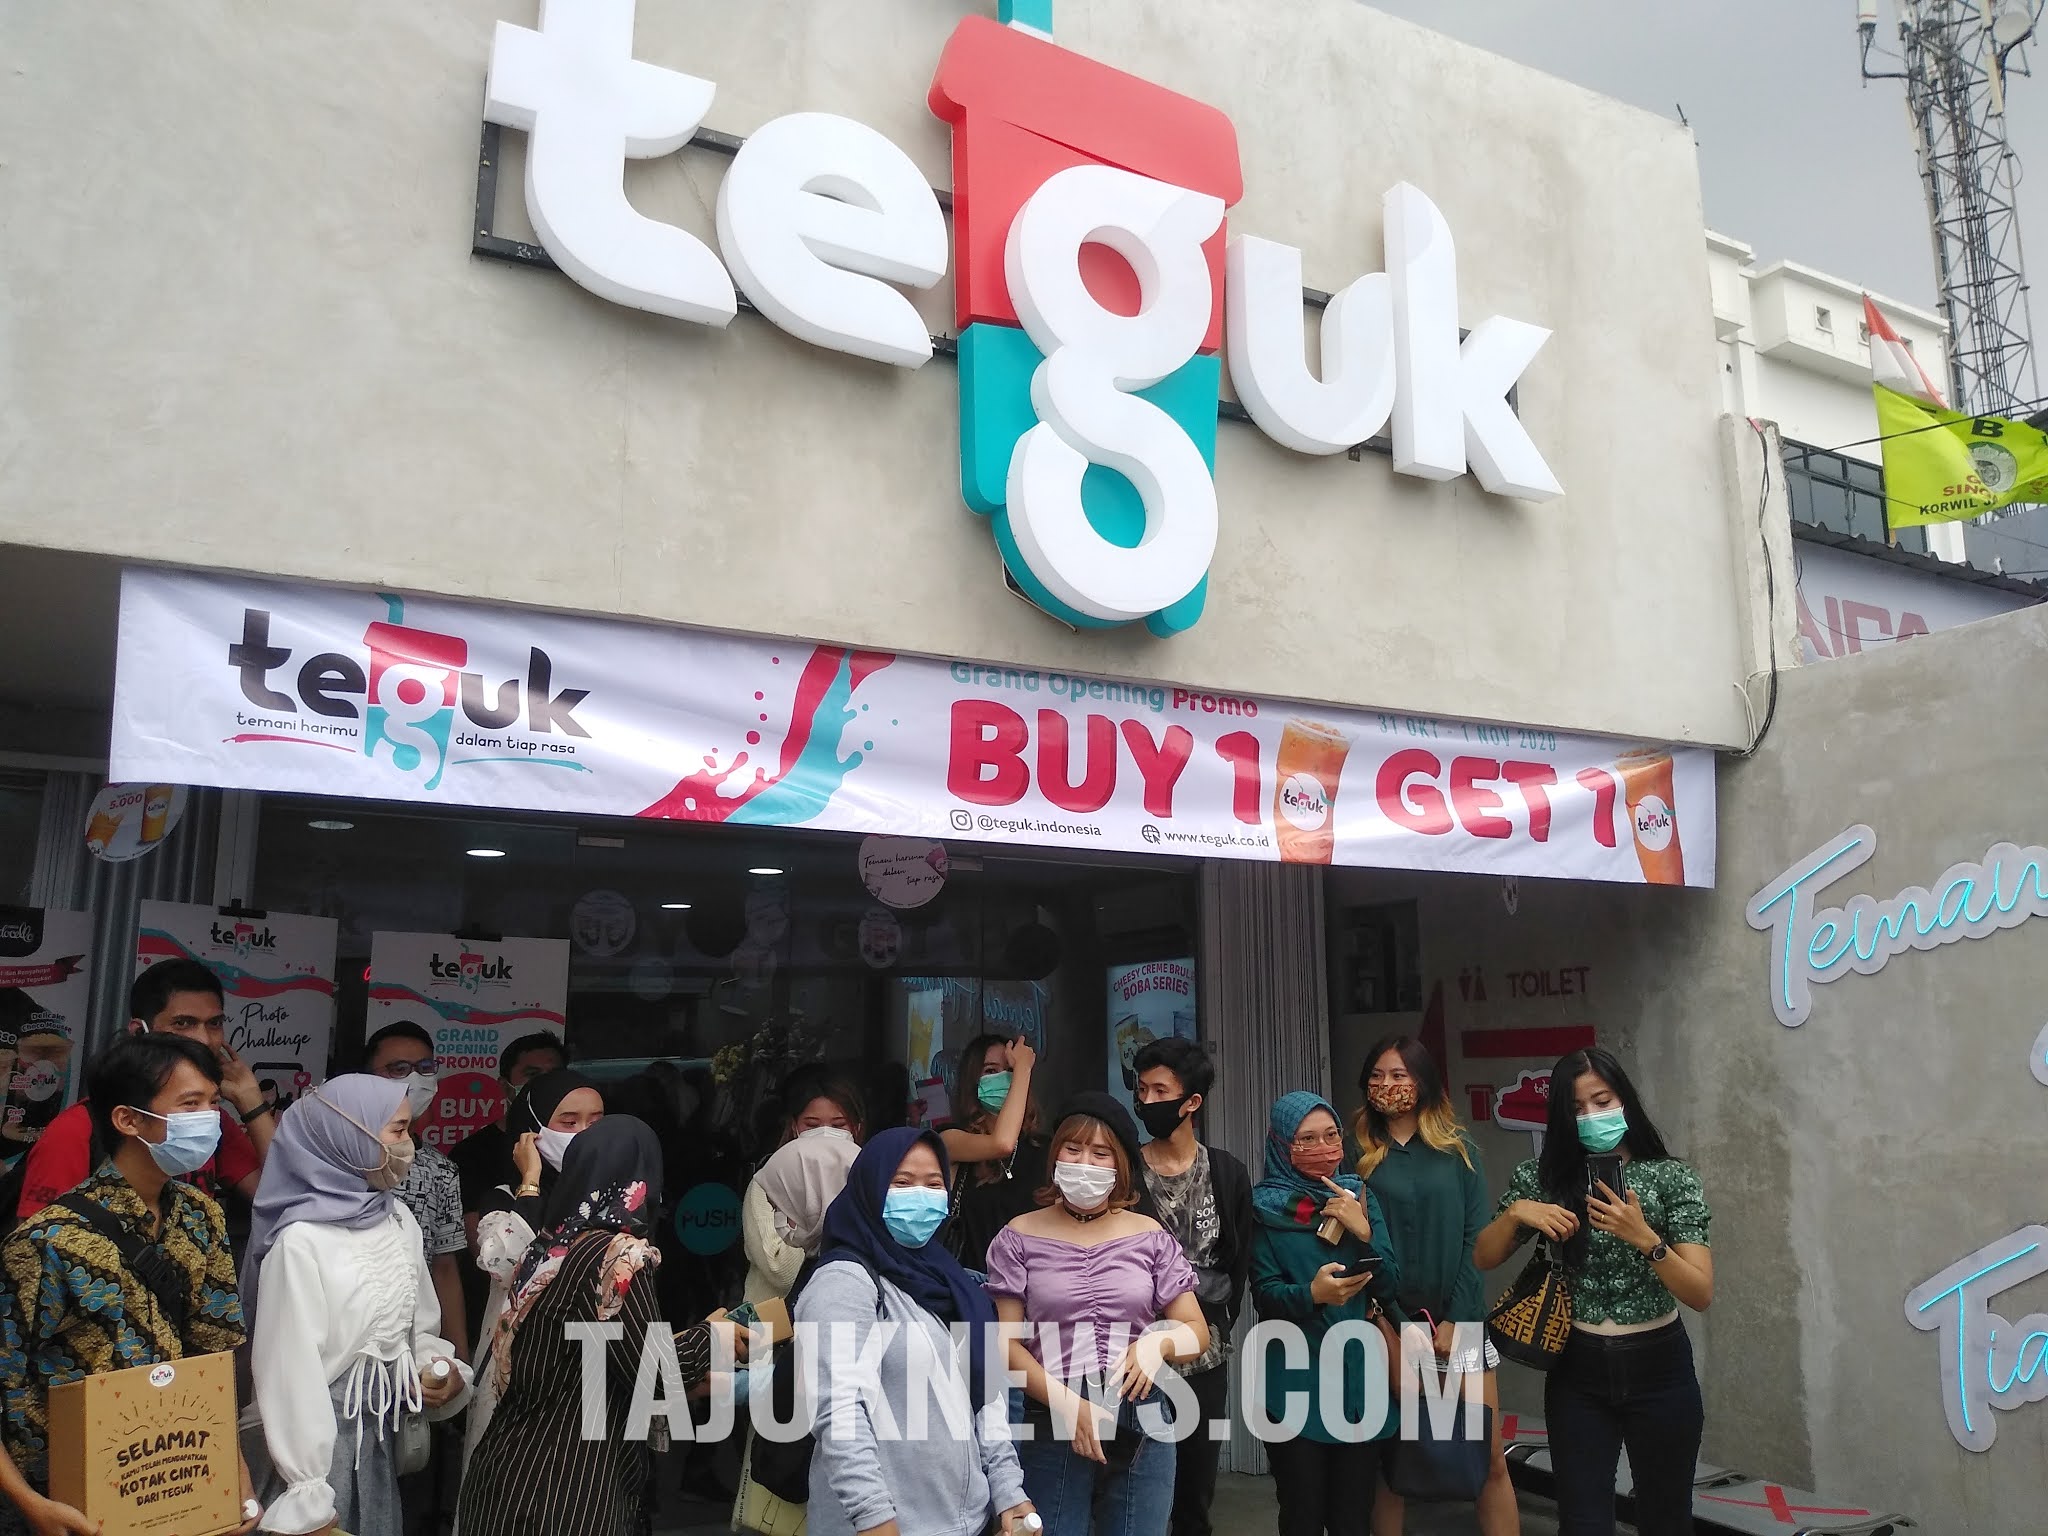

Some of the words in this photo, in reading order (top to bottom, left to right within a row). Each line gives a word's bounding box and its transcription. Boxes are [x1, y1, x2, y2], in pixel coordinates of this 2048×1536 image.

[484, 0, 1564, 620] teguk
[1920, 498, 1978, 515] KORWIL
[228, 608, 592, 790] teguk
[950, 661, 1039, 692] Grand
[1048, 673, 1165, 713] Opening
[1173, 687, 1258, 717] Promo
[236, 711, 297, 731] temani
[301, 718, 358, 737] harimu
[1377, 713, 1398, 735] 31
[1406, 716, 1439, 739] OKT
[1460, 722, 1470, 743] 1
[1477, 724, 1510, 747] NOV
[1517, 729, 1557, 752] 2020
[455, 732, 502, 748] dalam
[506, 735, 537, 756] tiap
[541, 742, 576, 754] rasa
[947, 699, 1194, 818] BUY
[1215, 730, 1263, 825] 1
[1376, 748, 1558, 843] GET
[1576, 767, 1618, 848] 1
[109, 793, 143, 809] 5.000
[977, 815, 1102, 837] @teguk.indonesia
[1165, 829, 1270, 849] www.teguk.co.id
[211, 922, 277, 960] teguk
[429, 953, 514, 994] teguk
[1113, 967, 1141, 993] CHEESY
[1141, 963, 1168, 976] CREME
[1506, 966, 1591, 998] TOILET
[1123, 977, 1151, 1001] BOBA
[1152, 976, 1189, 996] SERIES
[240, 1002, 290, 1027] Photo
[229, 1025, 312, 1055] Challenge
[435, 1028, 499, 1042] GRAND
[435, 1043, 499, 1055] OPENING
[436, 1056, 497, 1069] PROMO
[440, 1098, 495, 1119] BUY
[421, 1125, 474, 1146] GET
[682, 1207, 737, 1232] PUSH
[1196, 1204, 1216, 1218] SOC
[1202, 1229, 1219, 1239] CLU
[116, 1430, 210, 1468] SELAMAT
[119, 1470, 167, 1498] KOTAK
[169, 1463, 210, 1482] CINTA
[121, 1466, 141, 1481] KAMU
[141, 1459, 161, 1472] TELAH
[136, 1492, 160, 1506] DARI
[161, 1483, 194, 1500] TEGUK
